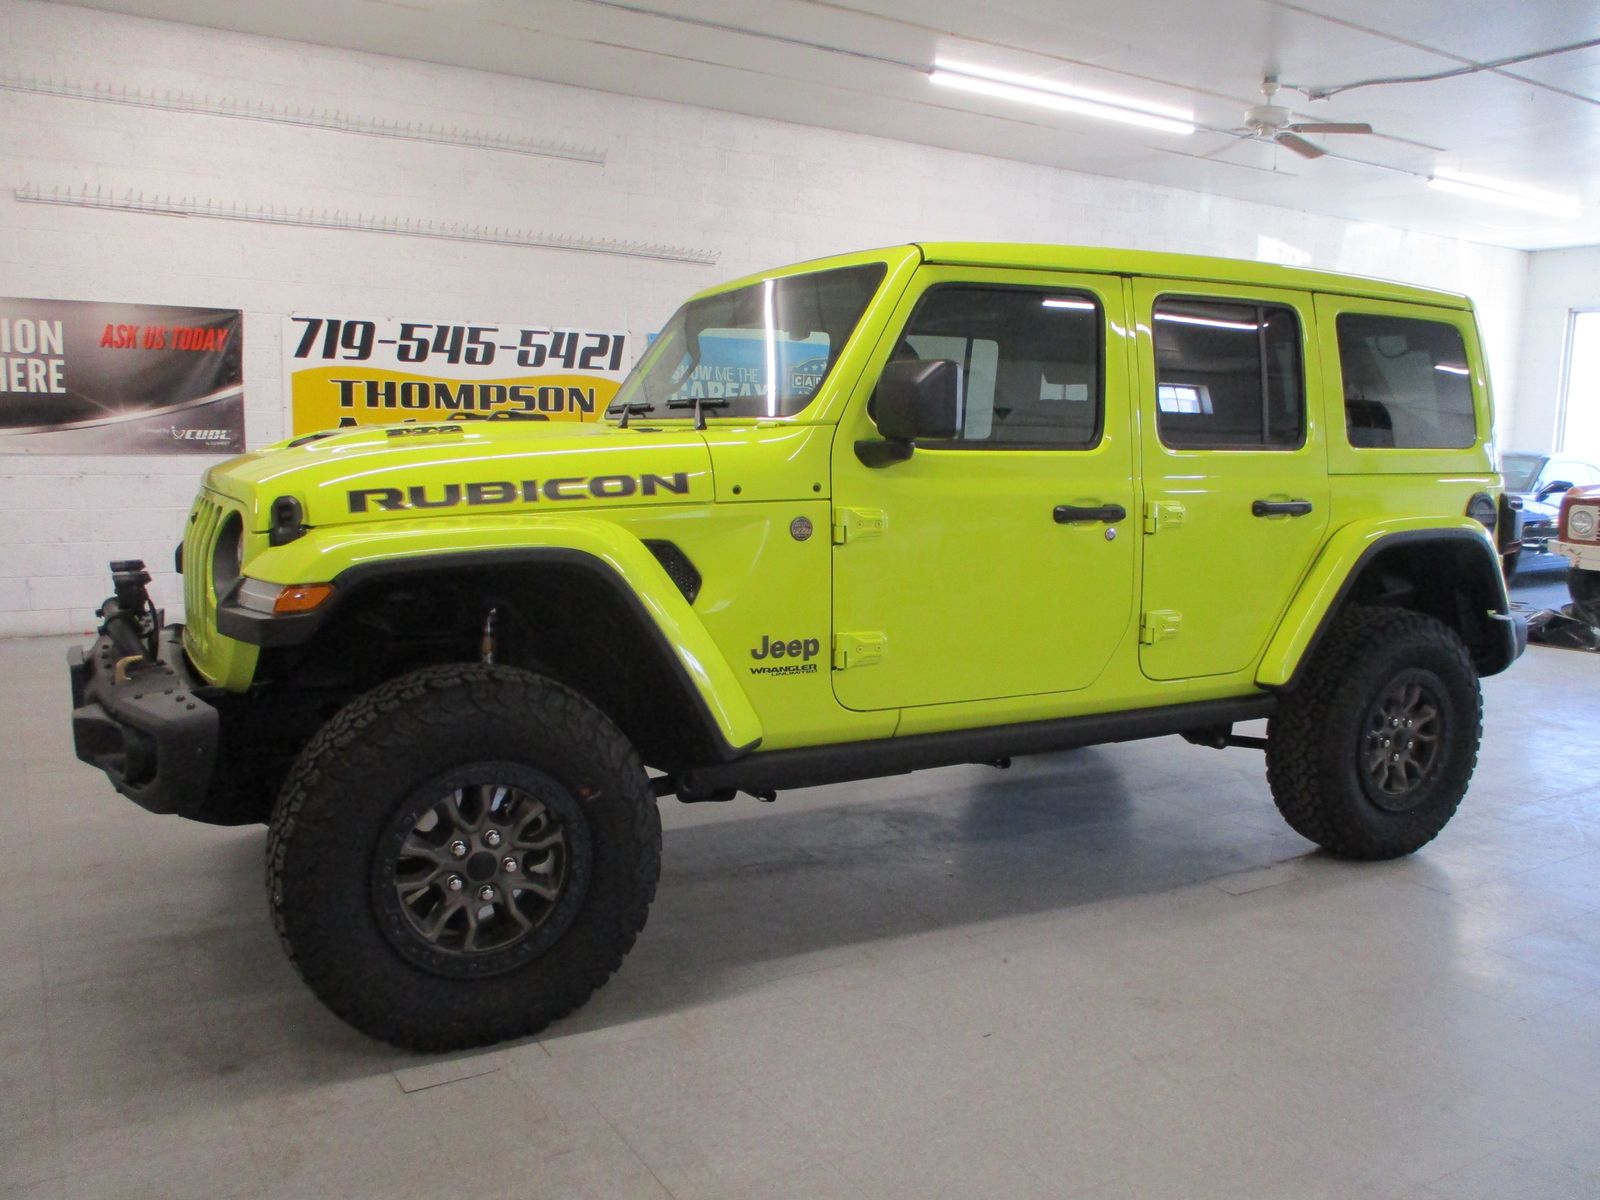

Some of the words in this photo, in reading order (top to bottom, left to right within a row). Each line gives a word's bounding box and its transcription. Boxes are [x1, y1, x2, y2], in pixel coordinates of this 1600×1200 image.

[1, 318, 64, 354] ION
[100, 324, 139, 349] ASK
[143, 325, 165, 349] US
[170, 326, 229, 352] TODAY
[291, 317, 625, 370] 719-545-5421
[715, 366, 735, 382] ME
[737, 367, 760, 384] THE
[330, 379, 595, 413] THOMPSON
[346, 472, 690, 514] RUBICON
[751, 635, 819, 661] Jeep
[750, 663, 817, 675] WRANGLER
